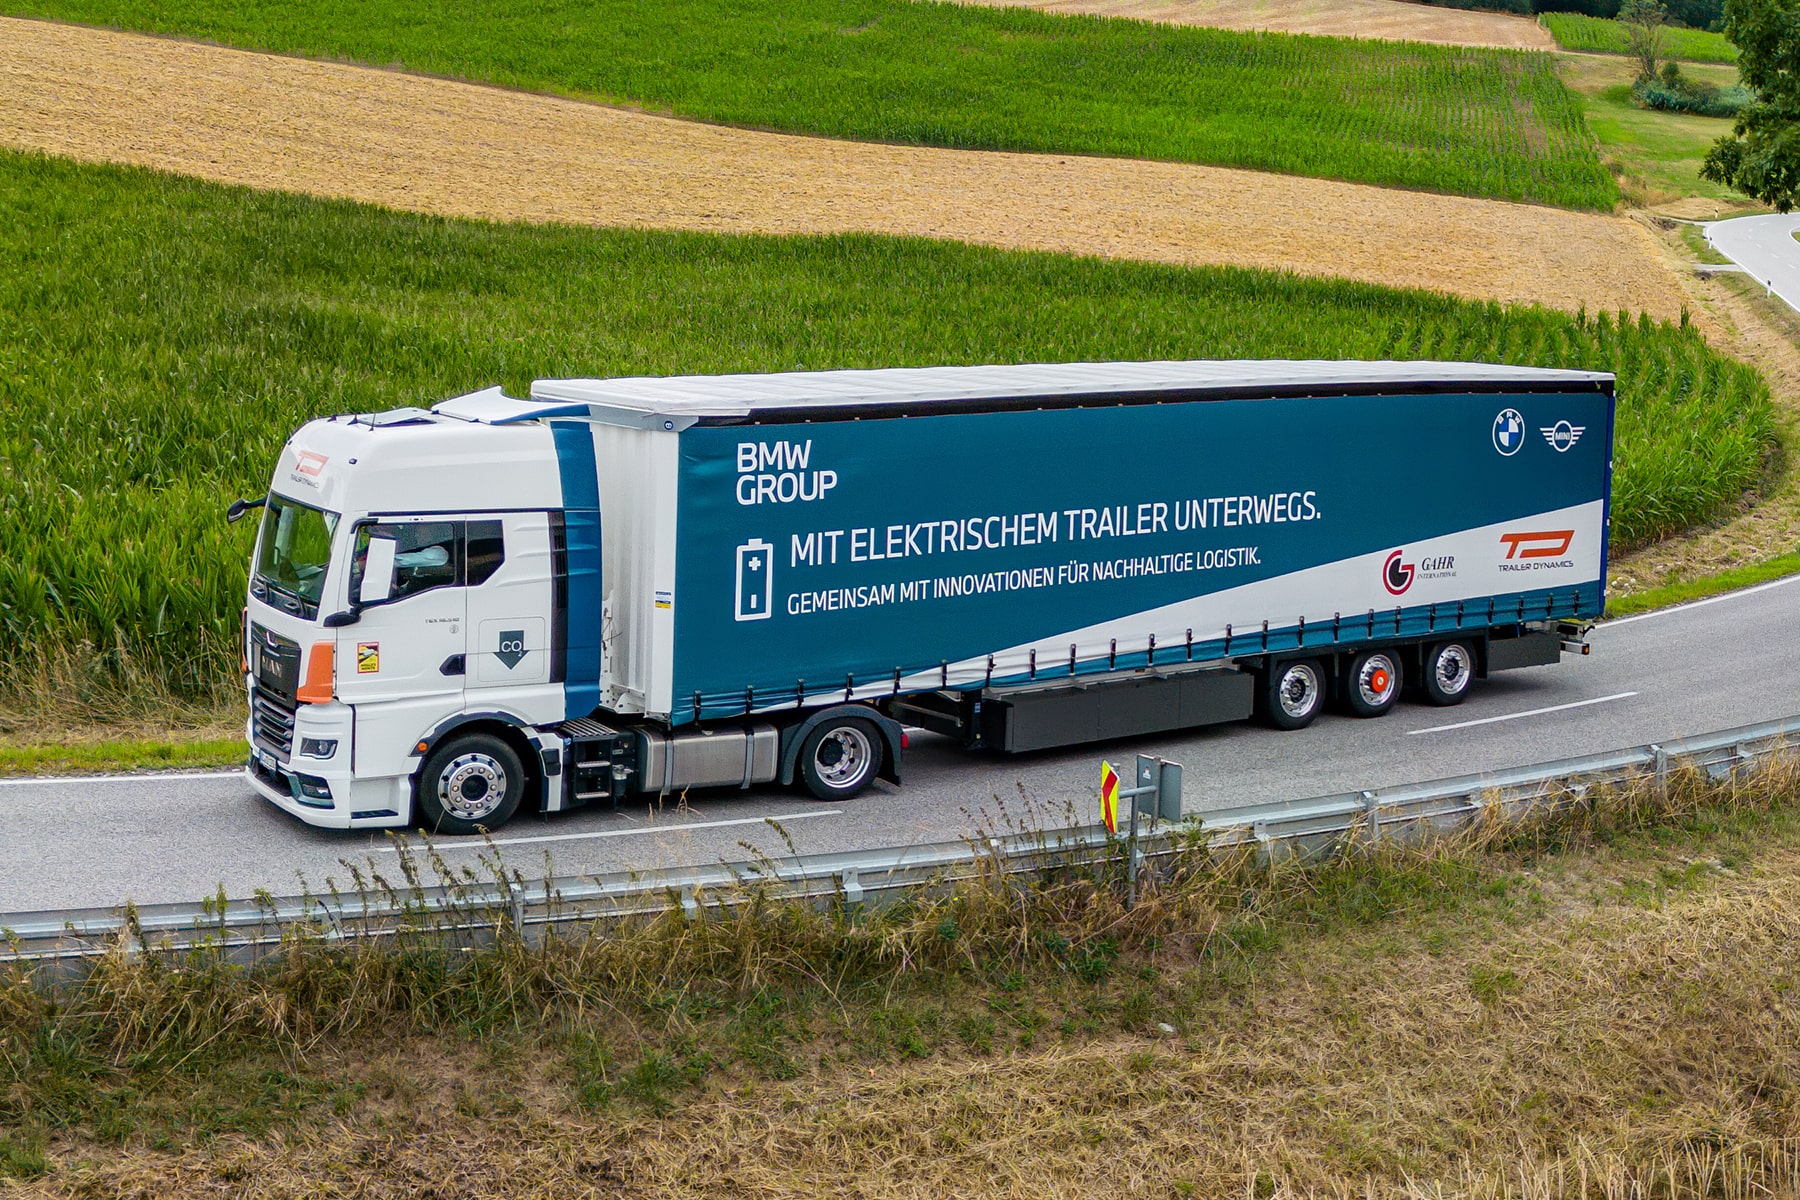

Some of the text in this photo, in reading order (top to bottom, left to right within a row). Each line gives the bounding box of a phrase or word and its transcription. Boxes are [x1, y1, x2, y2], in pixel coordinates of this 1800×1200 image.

[1555, 432, 1571, 441] MINI
[738, 440, 812, 472] BMW
[737, 471, 838, 505] GROUP
[792, 491, 1321, 567] MIT ELEKTRISCHEM TRAILER UNTERWEGS.
[1421, 555, 1455, 571] GAHR
[1498, 560, 1574, 572] TRAILER DYNAMICS
[788, 546, 1262, 615] GEMEINSAM MIT INNOVATIONEN FÜR NACHHALTIGE LOGISTIK.
